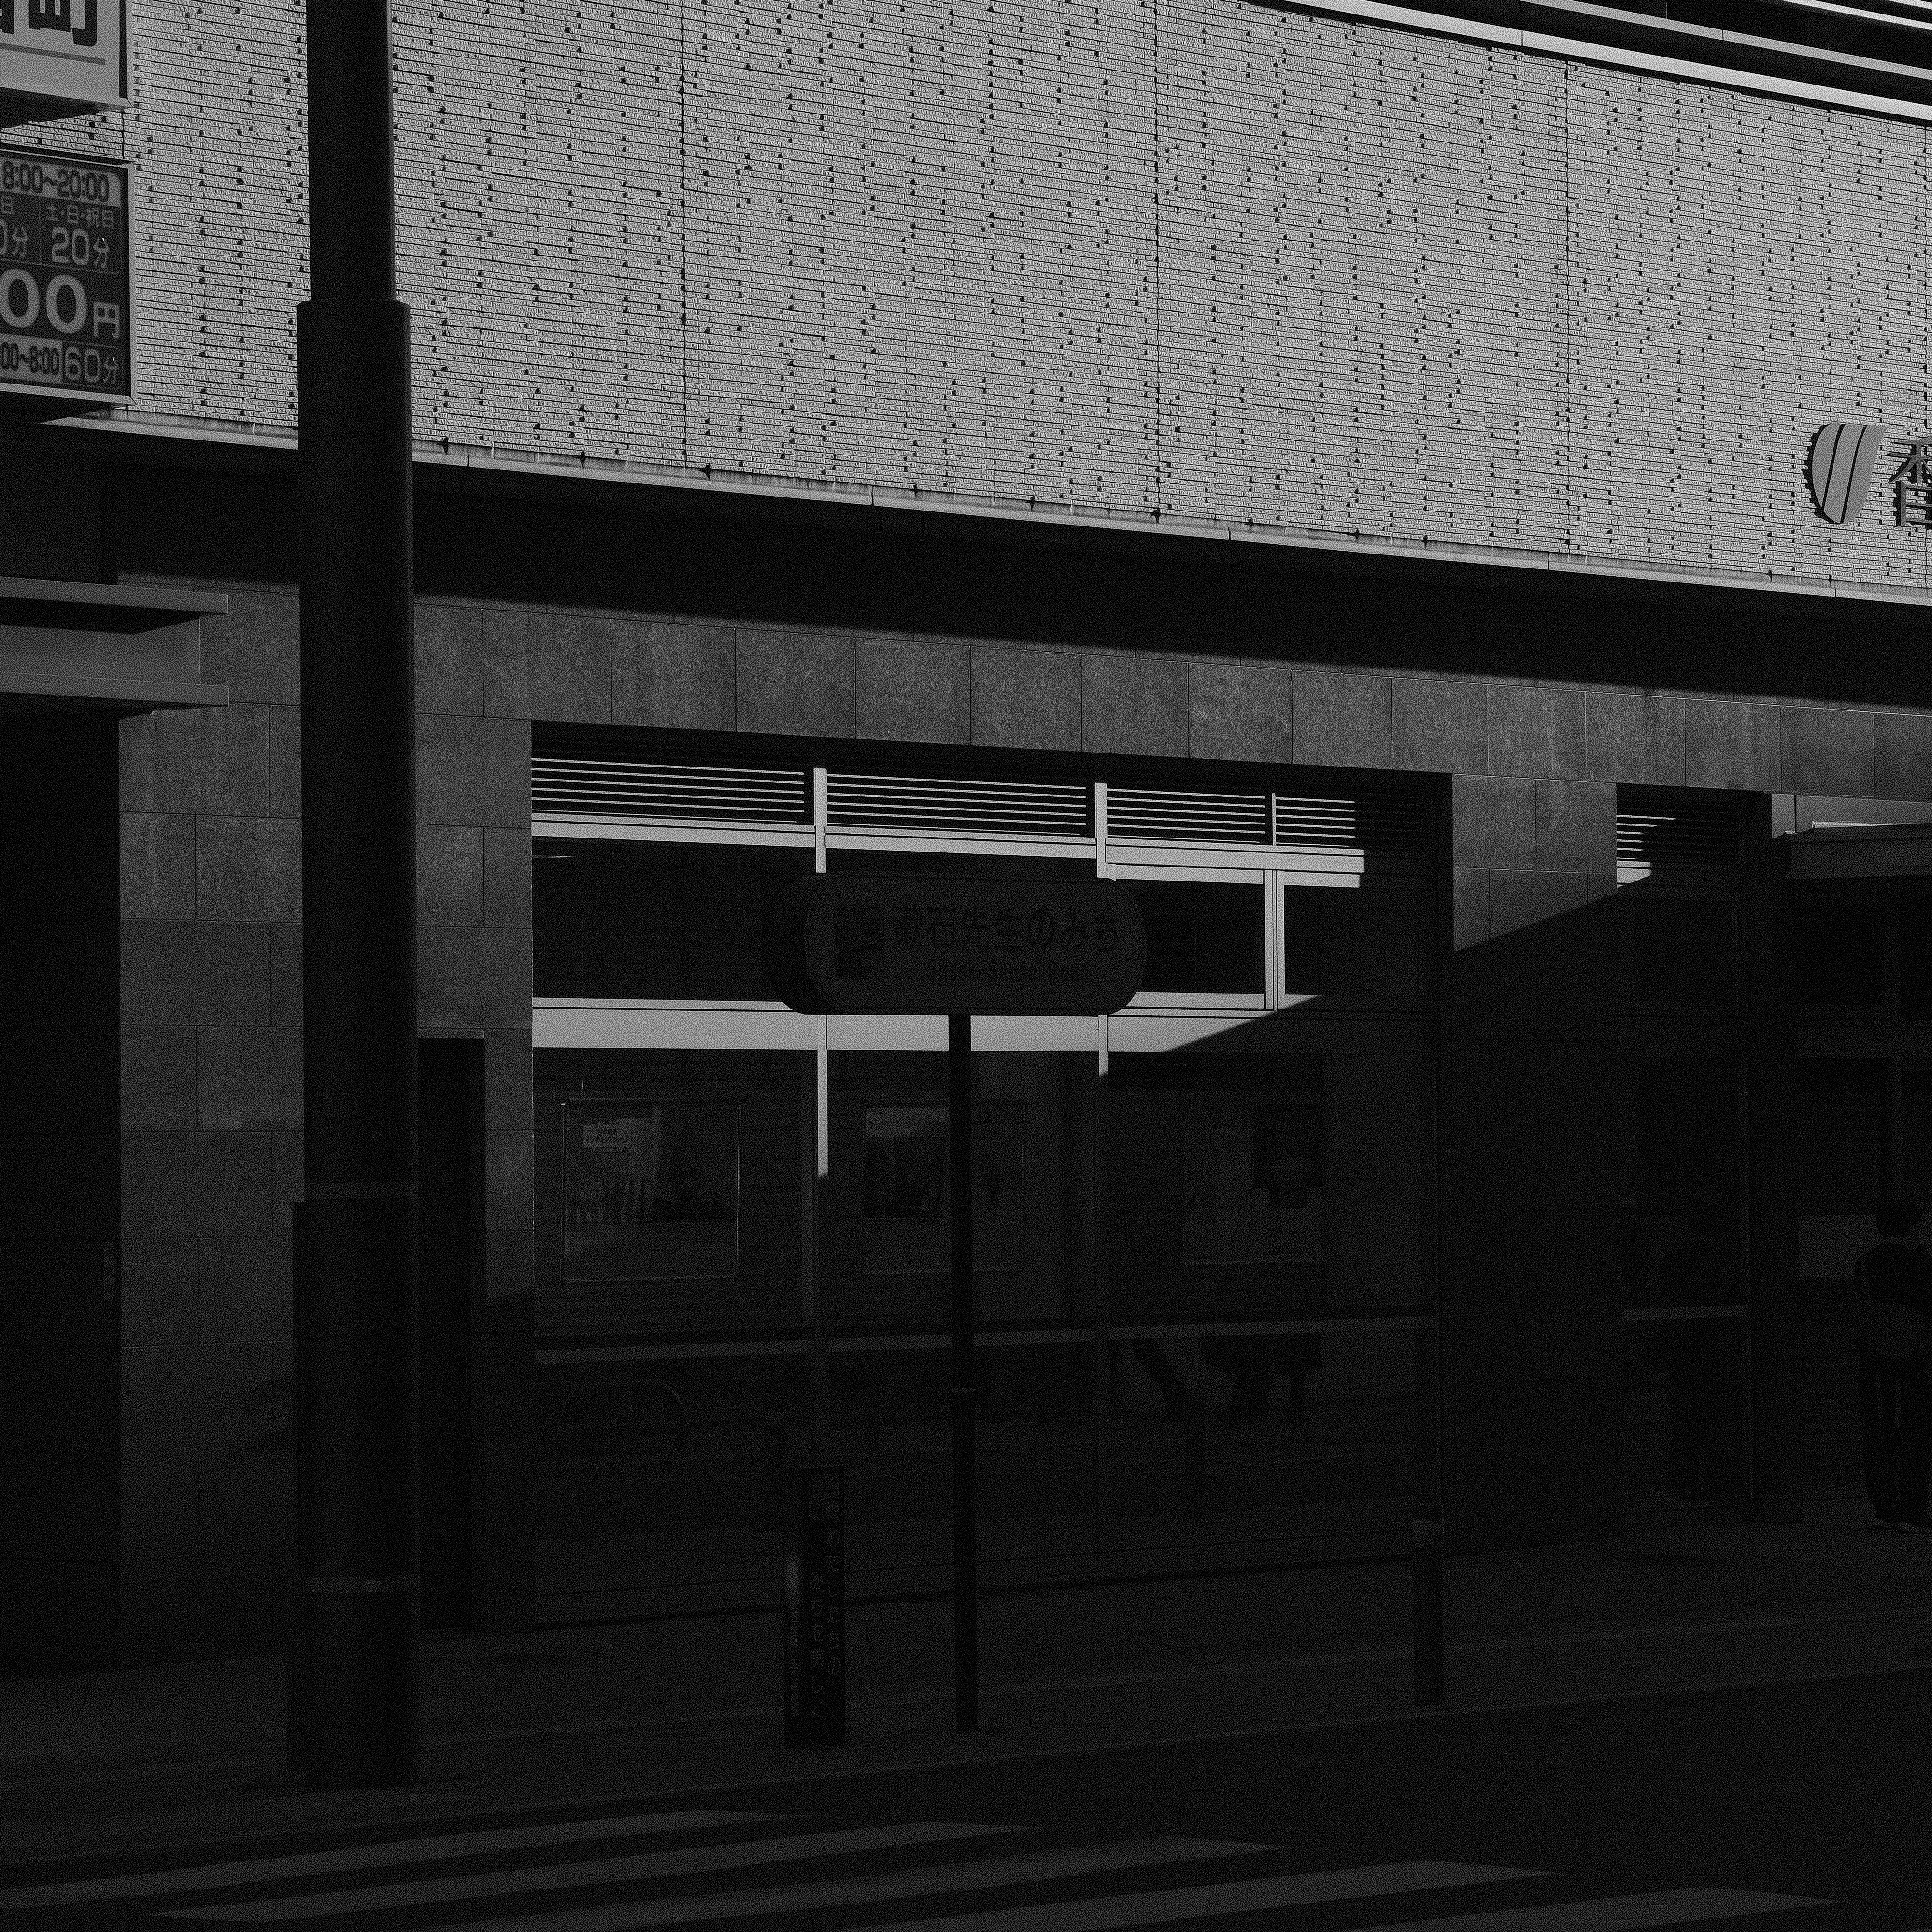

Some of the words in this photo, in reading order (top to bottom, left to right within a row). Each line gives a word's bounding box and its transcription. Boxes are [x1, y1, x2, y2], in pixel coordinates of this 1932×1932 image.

[51, 226, 110, 269] 20分
[65, 346, 119, 385] 60分
[892, 903, 1119, 953] 漱石先生のみち
[1048, 959, 1090, 983] Road
[826, 1529, 841, 1676] わたしたちの
[810, 1571, 824, 1720] みちを美しく
